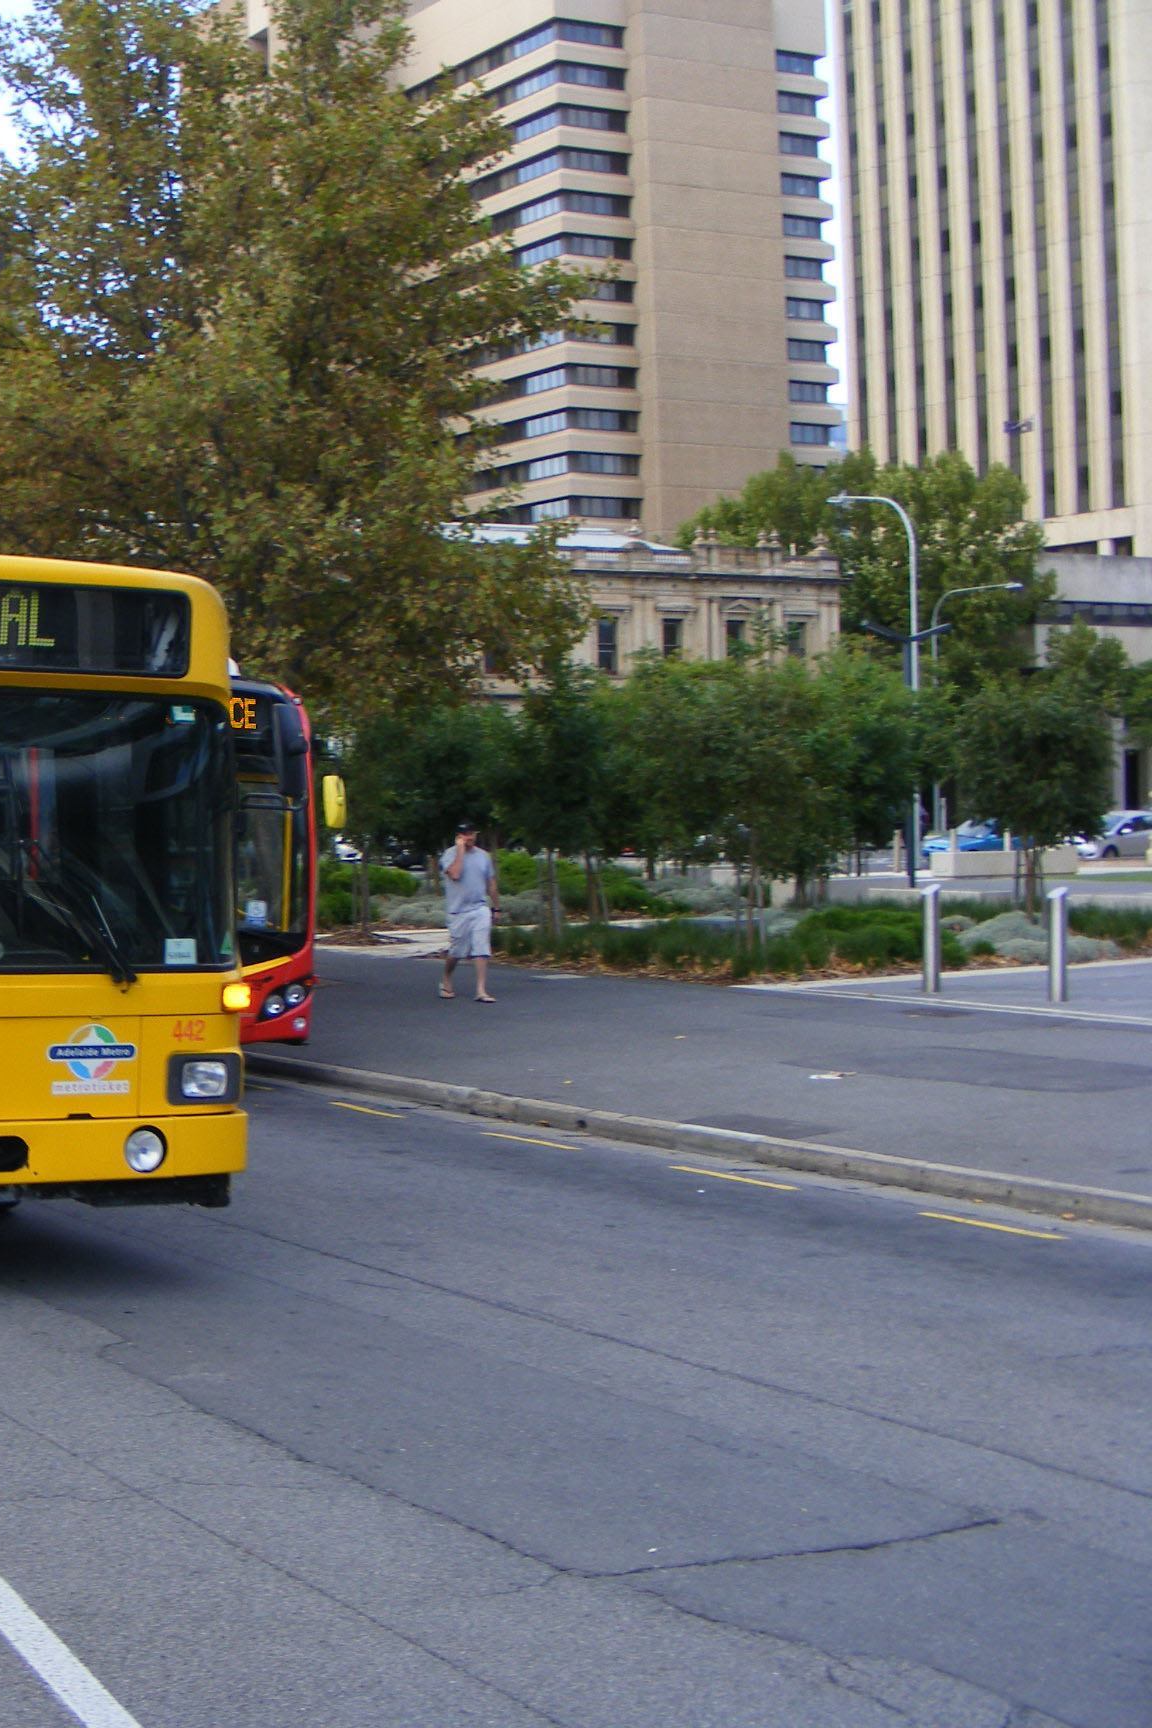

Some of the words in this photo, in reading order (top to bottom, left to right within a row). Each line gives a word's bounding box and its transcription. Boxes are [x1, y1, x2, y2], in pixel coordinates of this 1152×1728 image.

[172, 1019, 205, 1043] 442
[55, 1046, 99, 1058] Adelaide
[101, 1046, 131, 1057] Metro
